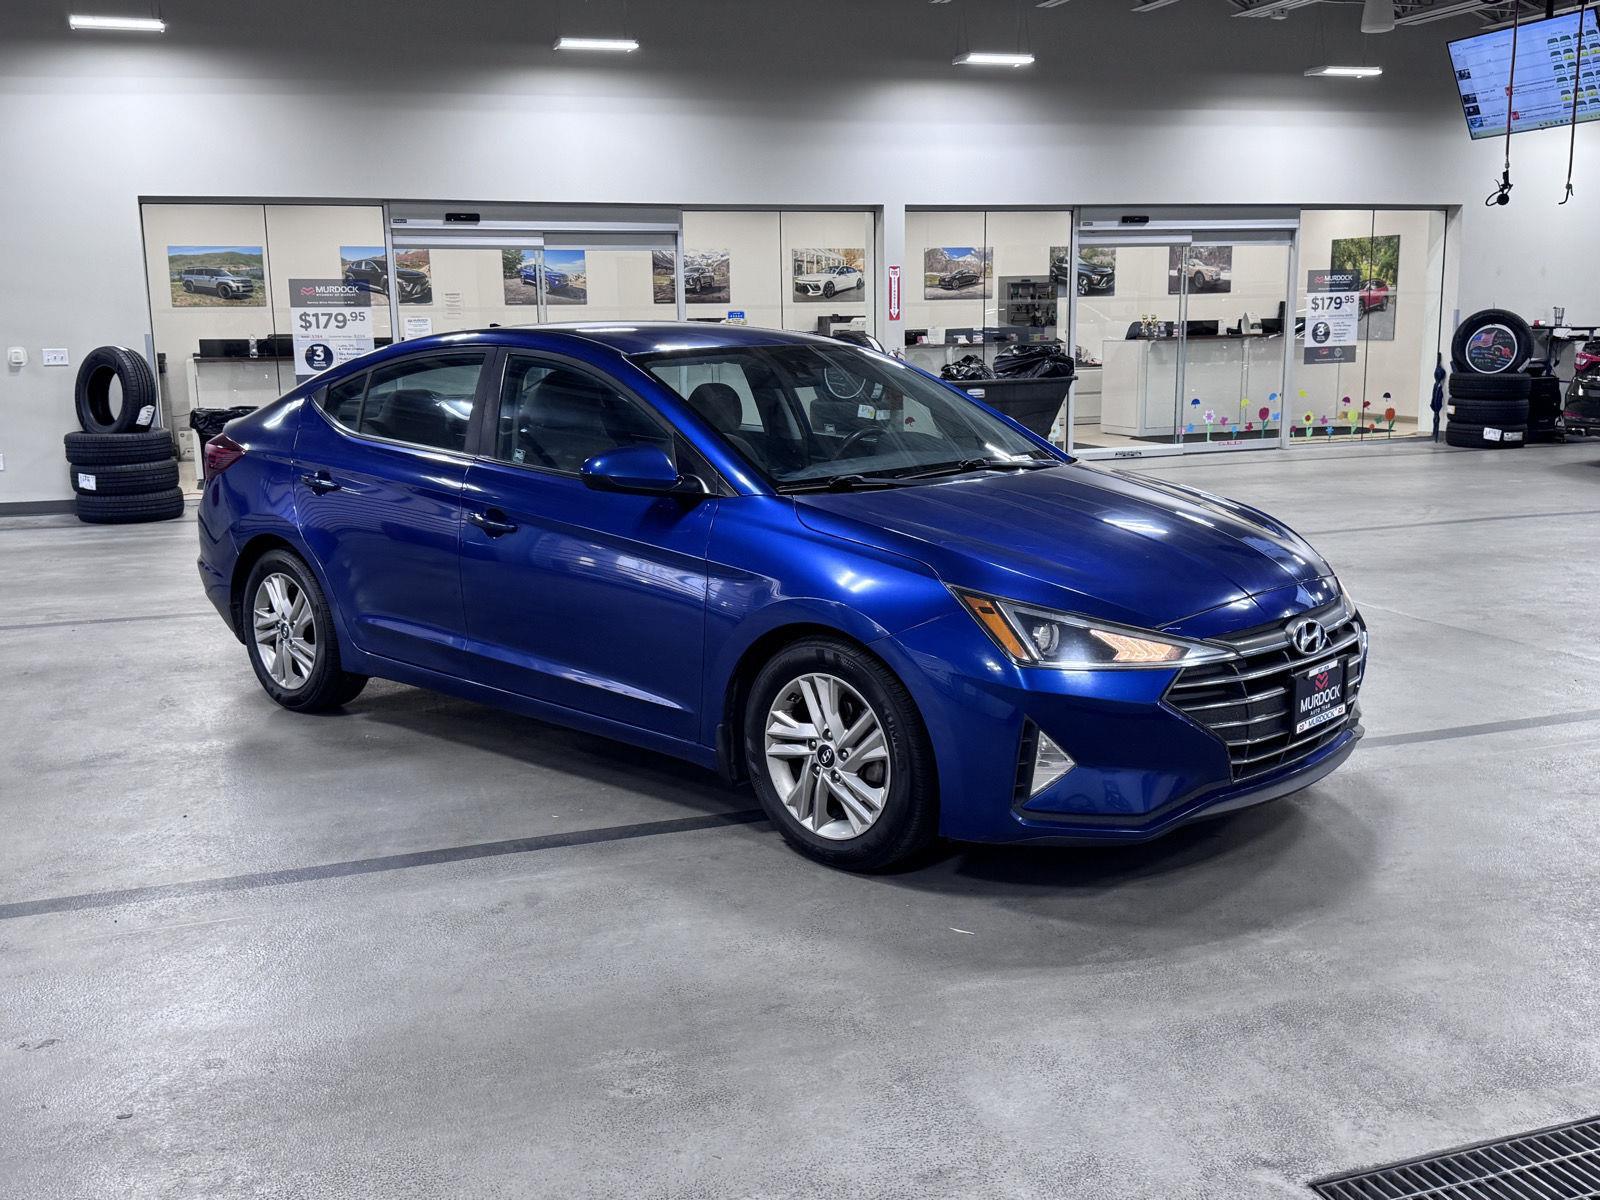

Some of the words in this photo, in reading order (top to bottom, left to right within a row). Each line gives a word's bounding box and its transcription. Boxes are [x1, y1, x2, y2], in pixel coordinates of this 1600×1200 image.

[315, 285, 360, 293] MURDOCK
[299, 311, 366, 331] $179.95
[313, 346, 325, 361] 3
[1300, 684, 1341, 713] MURDOCK
[1308, 710, 1335, 726] MURDOCK
